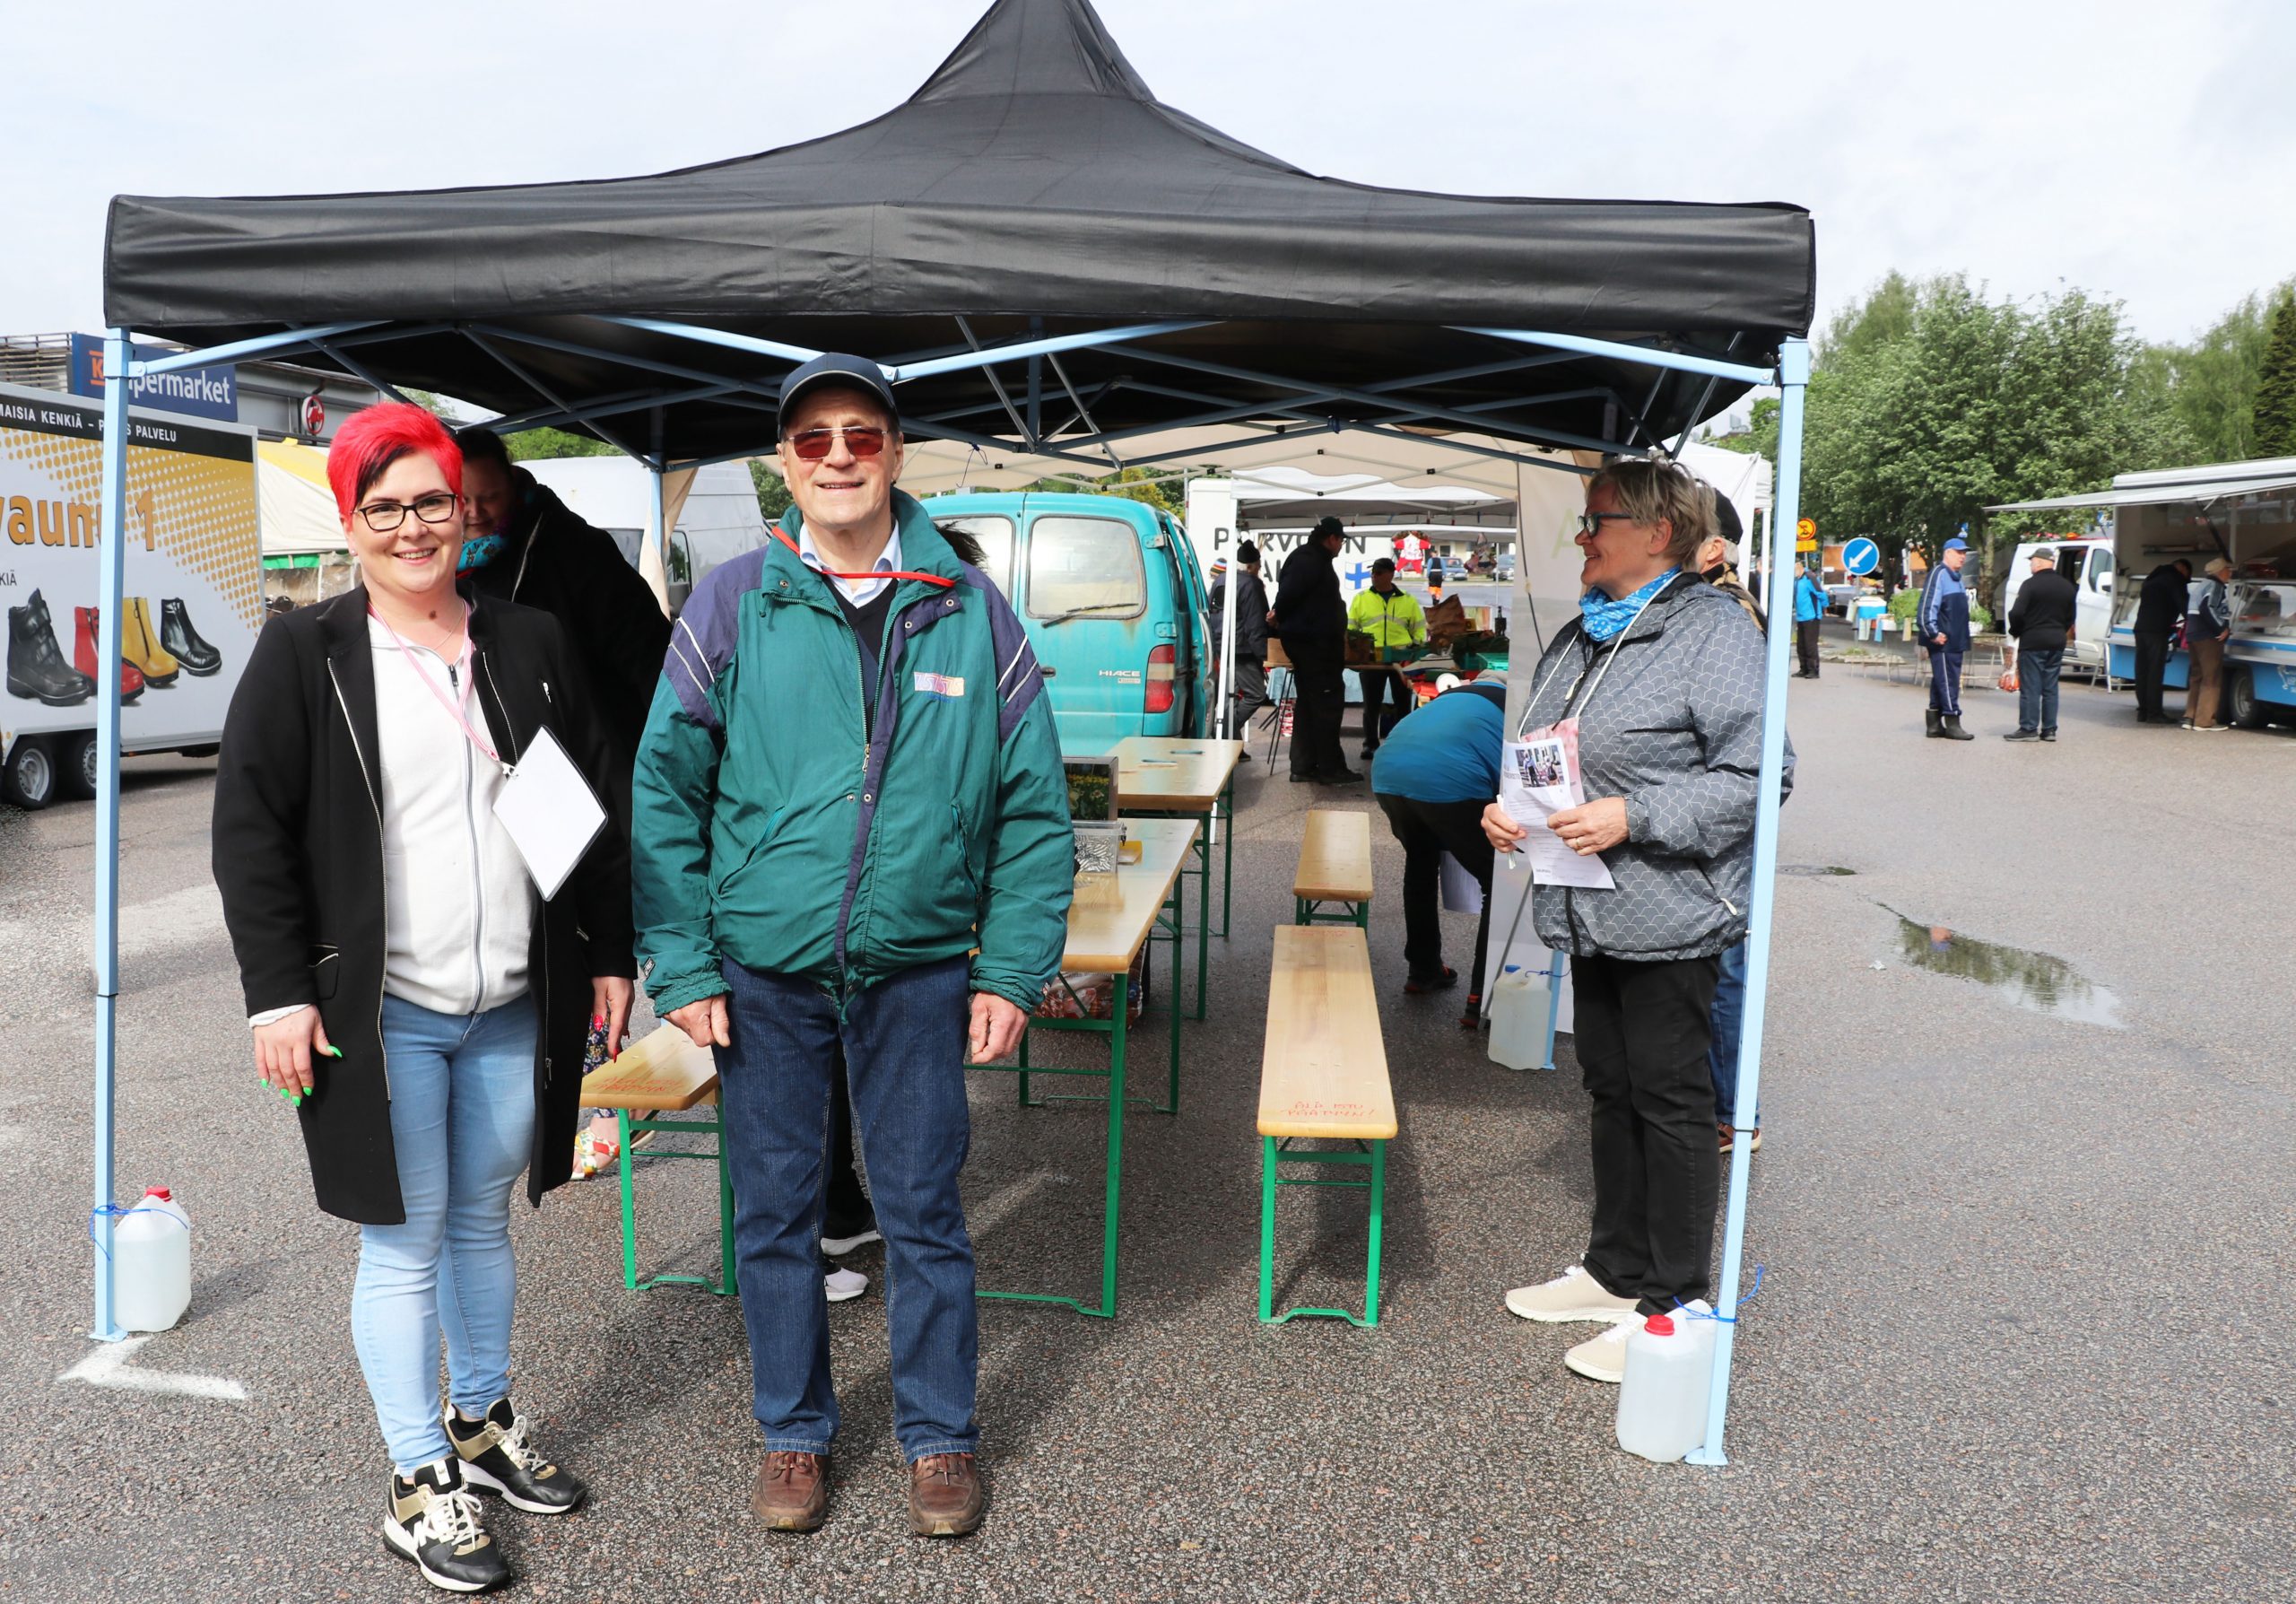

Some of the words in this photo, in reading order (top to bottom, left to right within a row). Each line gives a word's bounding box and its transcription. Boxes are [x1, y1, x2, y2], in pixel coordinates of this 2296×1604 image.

[128, 370, 231, 404] permarket
[41, 410, 83, 429] KENKIÄ
[135, 424, 177, 442] PALVELU
[0, 495, 102, 548] aun
[135, 485, 155, 552] 1
[1099, 669, 1141, 677] HIACE
